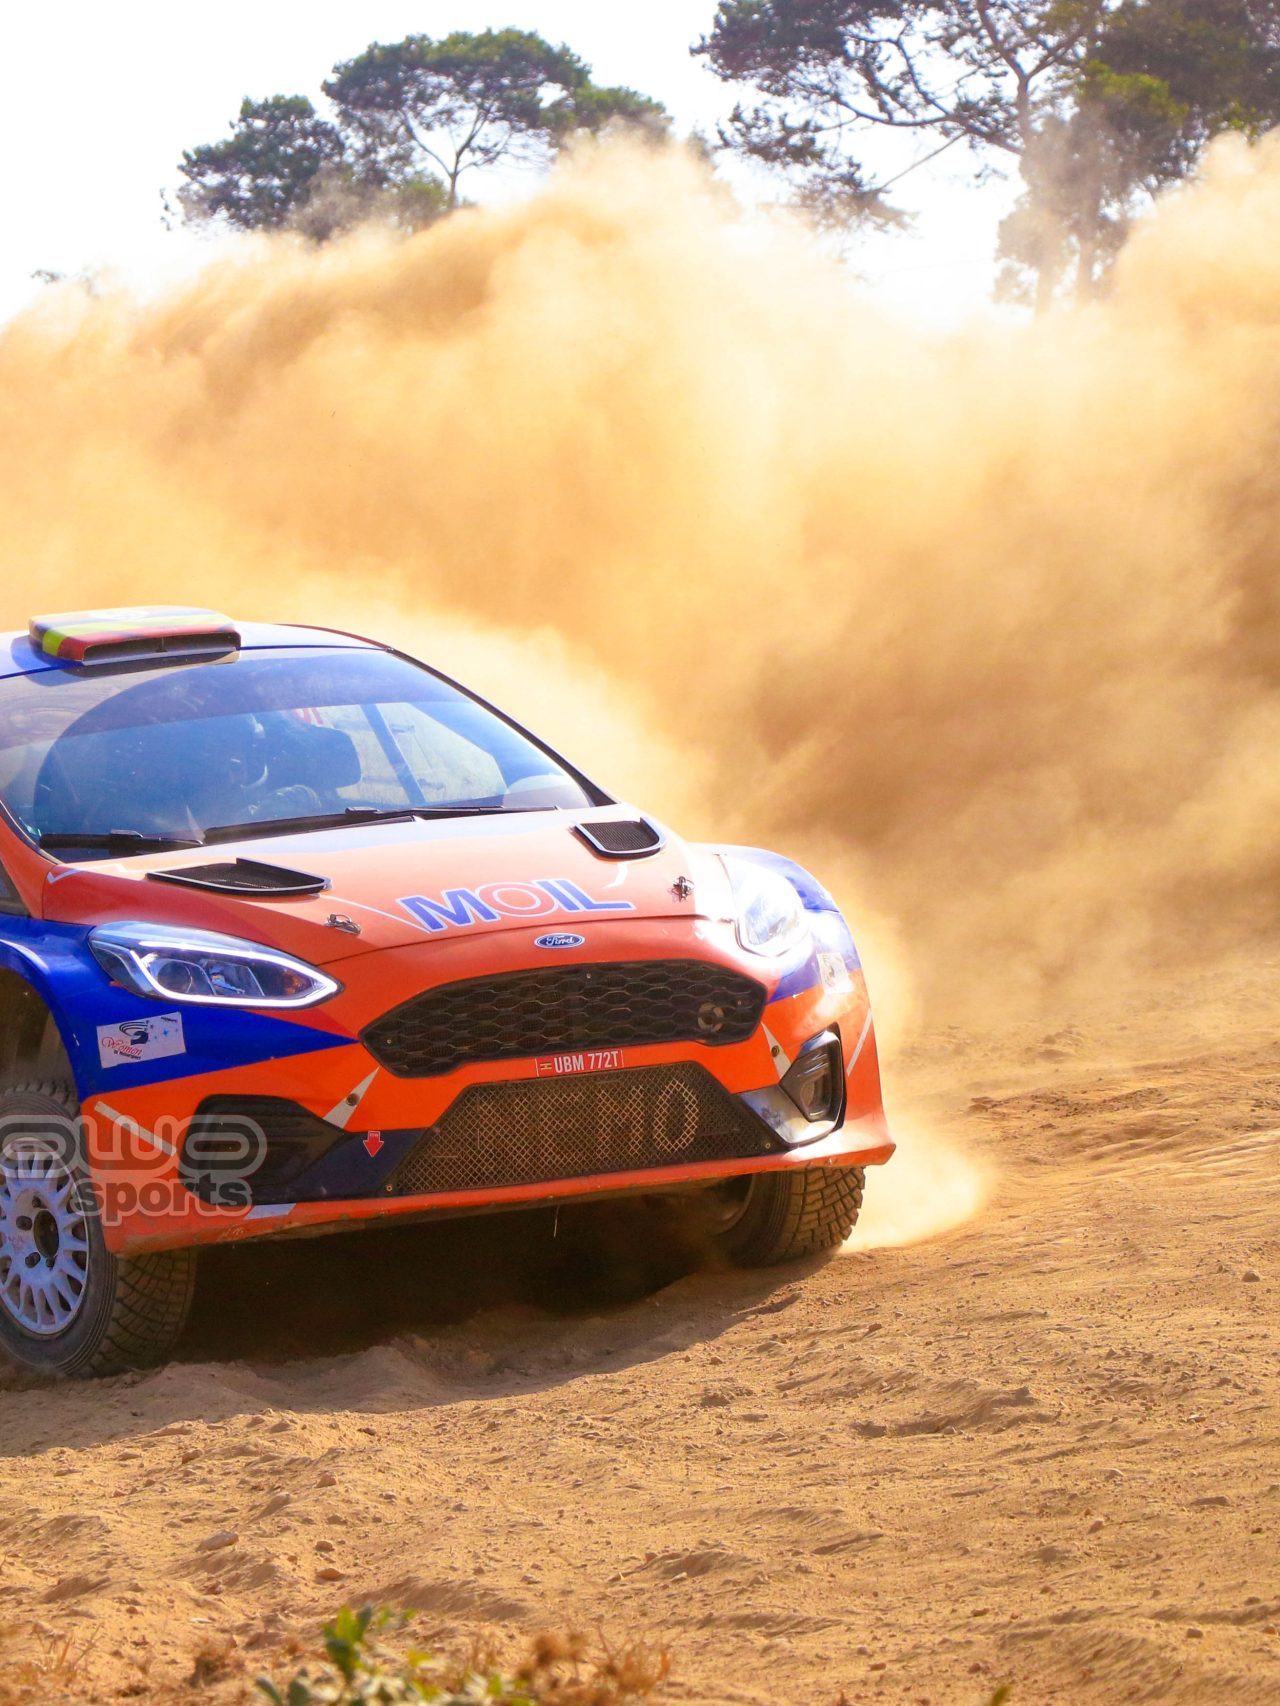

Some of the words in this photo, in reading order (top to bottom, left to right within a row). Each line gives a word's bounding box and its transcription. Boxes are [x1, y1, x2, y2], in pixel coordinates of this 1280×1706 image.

[397, 879, 635, 931] MOIL
[554, 1055, 584, 1073] UBM
[588, 1051, 619, 1069] 772T
